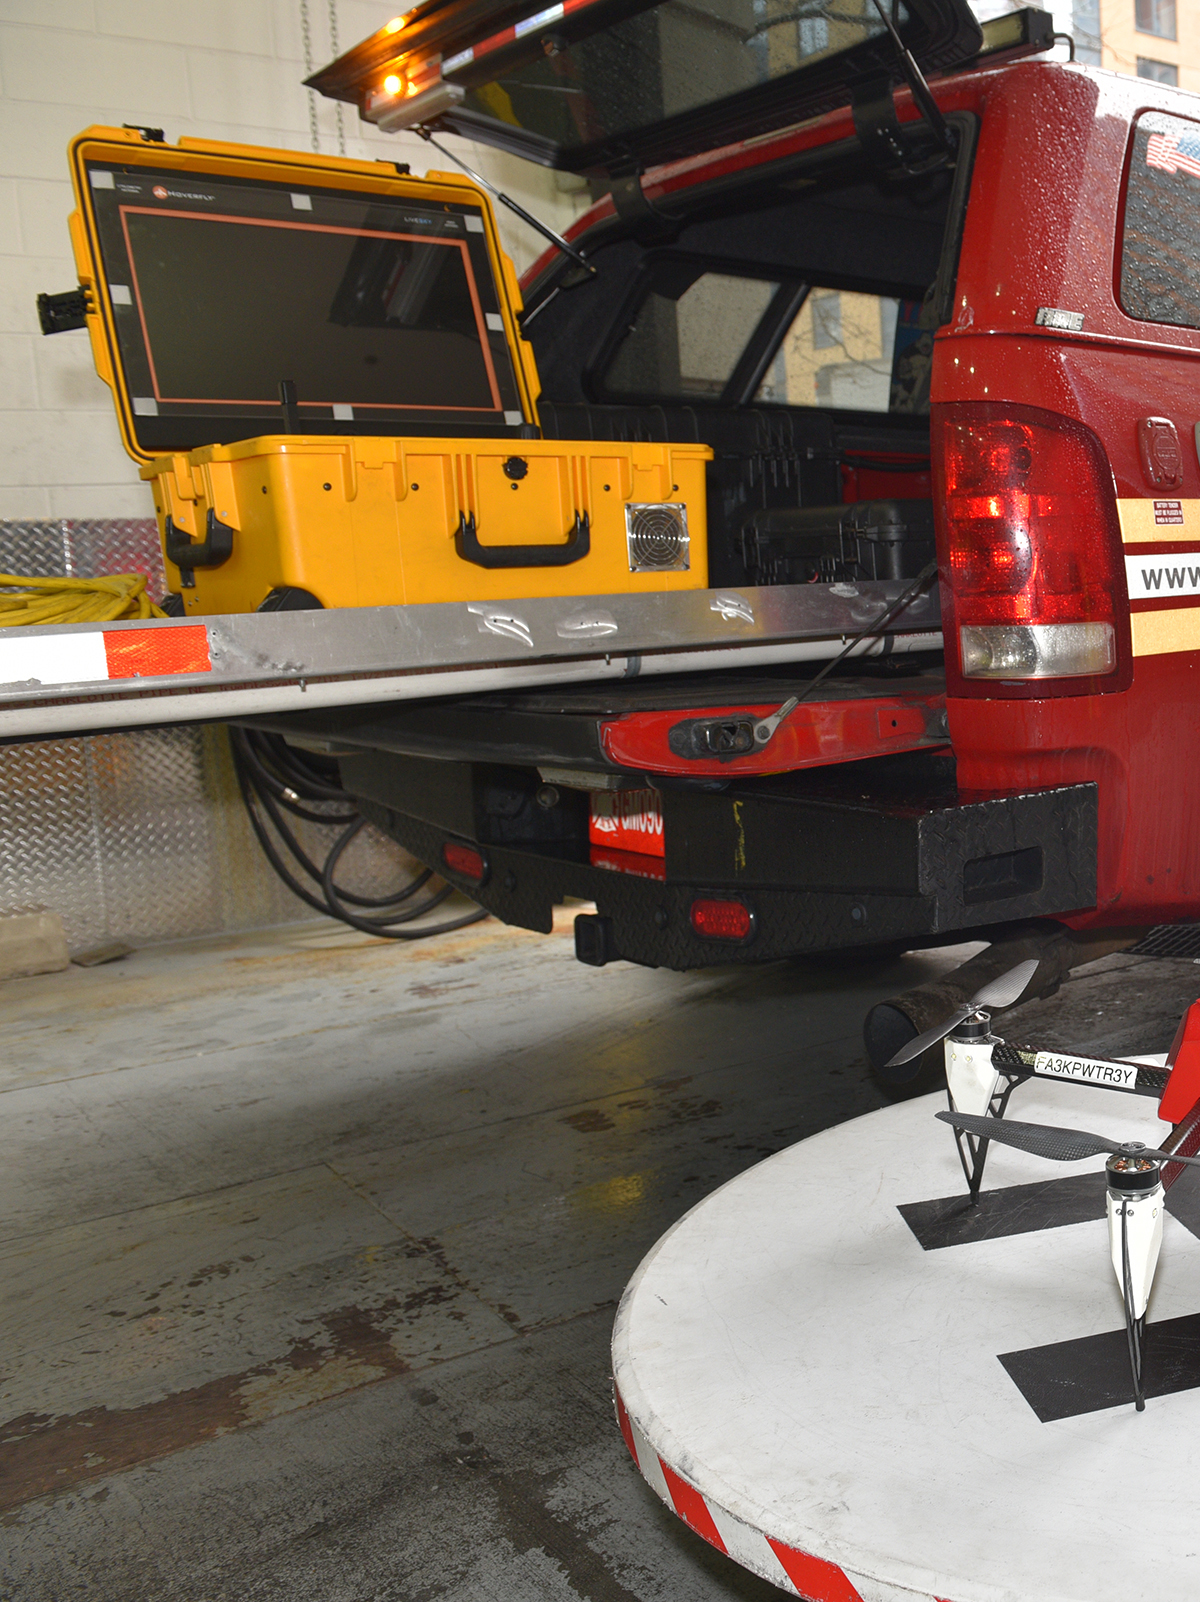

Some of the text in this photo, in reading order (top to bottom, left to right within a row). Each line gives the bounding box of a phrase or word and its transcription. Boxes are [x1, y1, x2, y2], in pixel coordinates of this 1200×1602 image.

[167, 190, 214, 201] HOVERFLY
[139, 687, 179, 698] PIPE
[1036, 1056, 1133, 1084] FA3KPWTR3Y
